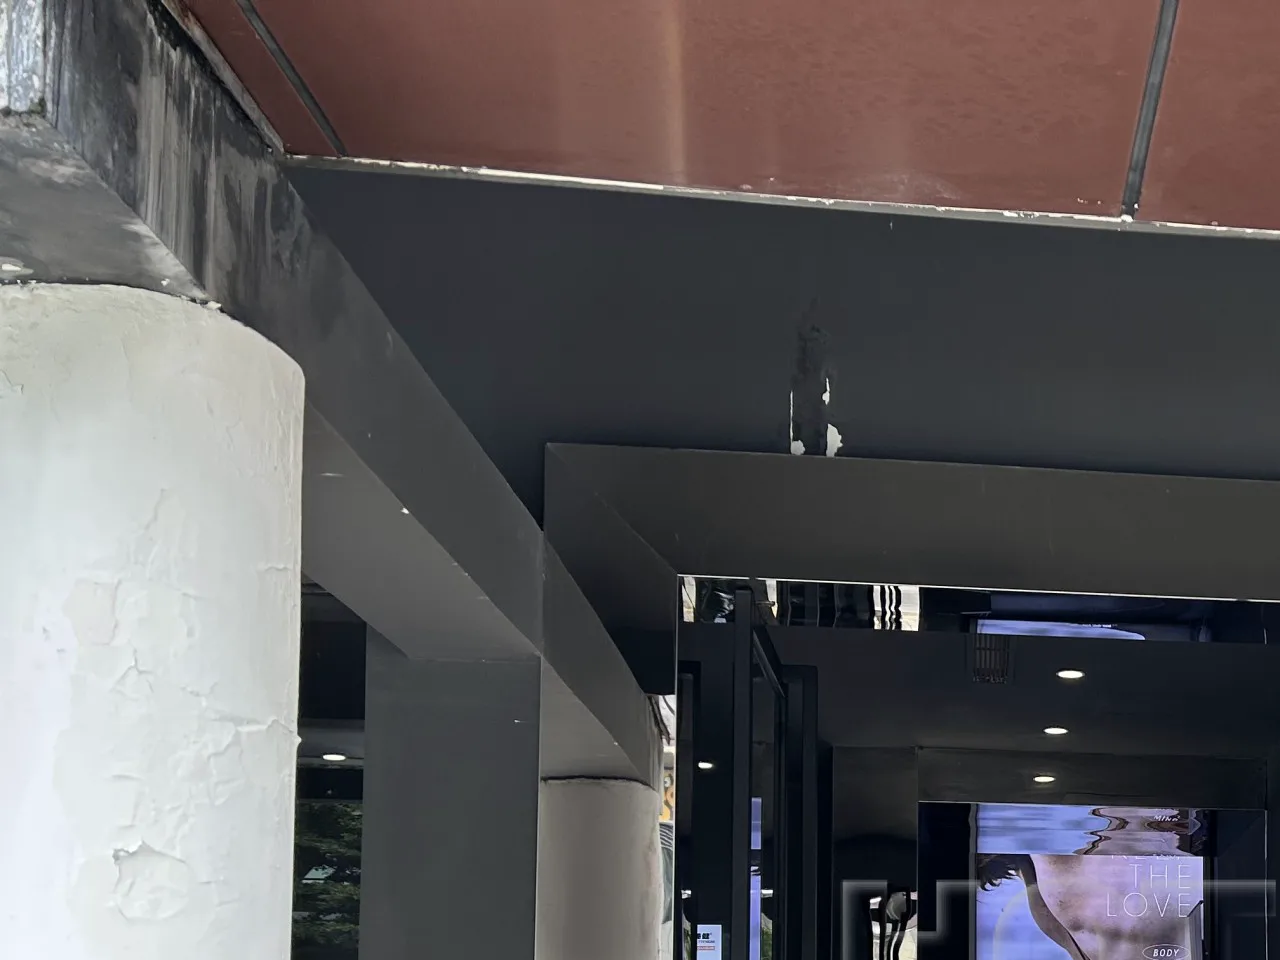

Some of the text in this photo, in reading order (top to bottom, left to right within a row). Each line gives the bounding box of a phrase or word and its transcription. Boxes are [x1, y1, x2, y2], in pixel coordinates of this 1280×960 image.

[1129, 864, 1191, 889] THE
[1106, 892, 1191, 918] LOVE
[1153, 948, 1179, 958] BODY
